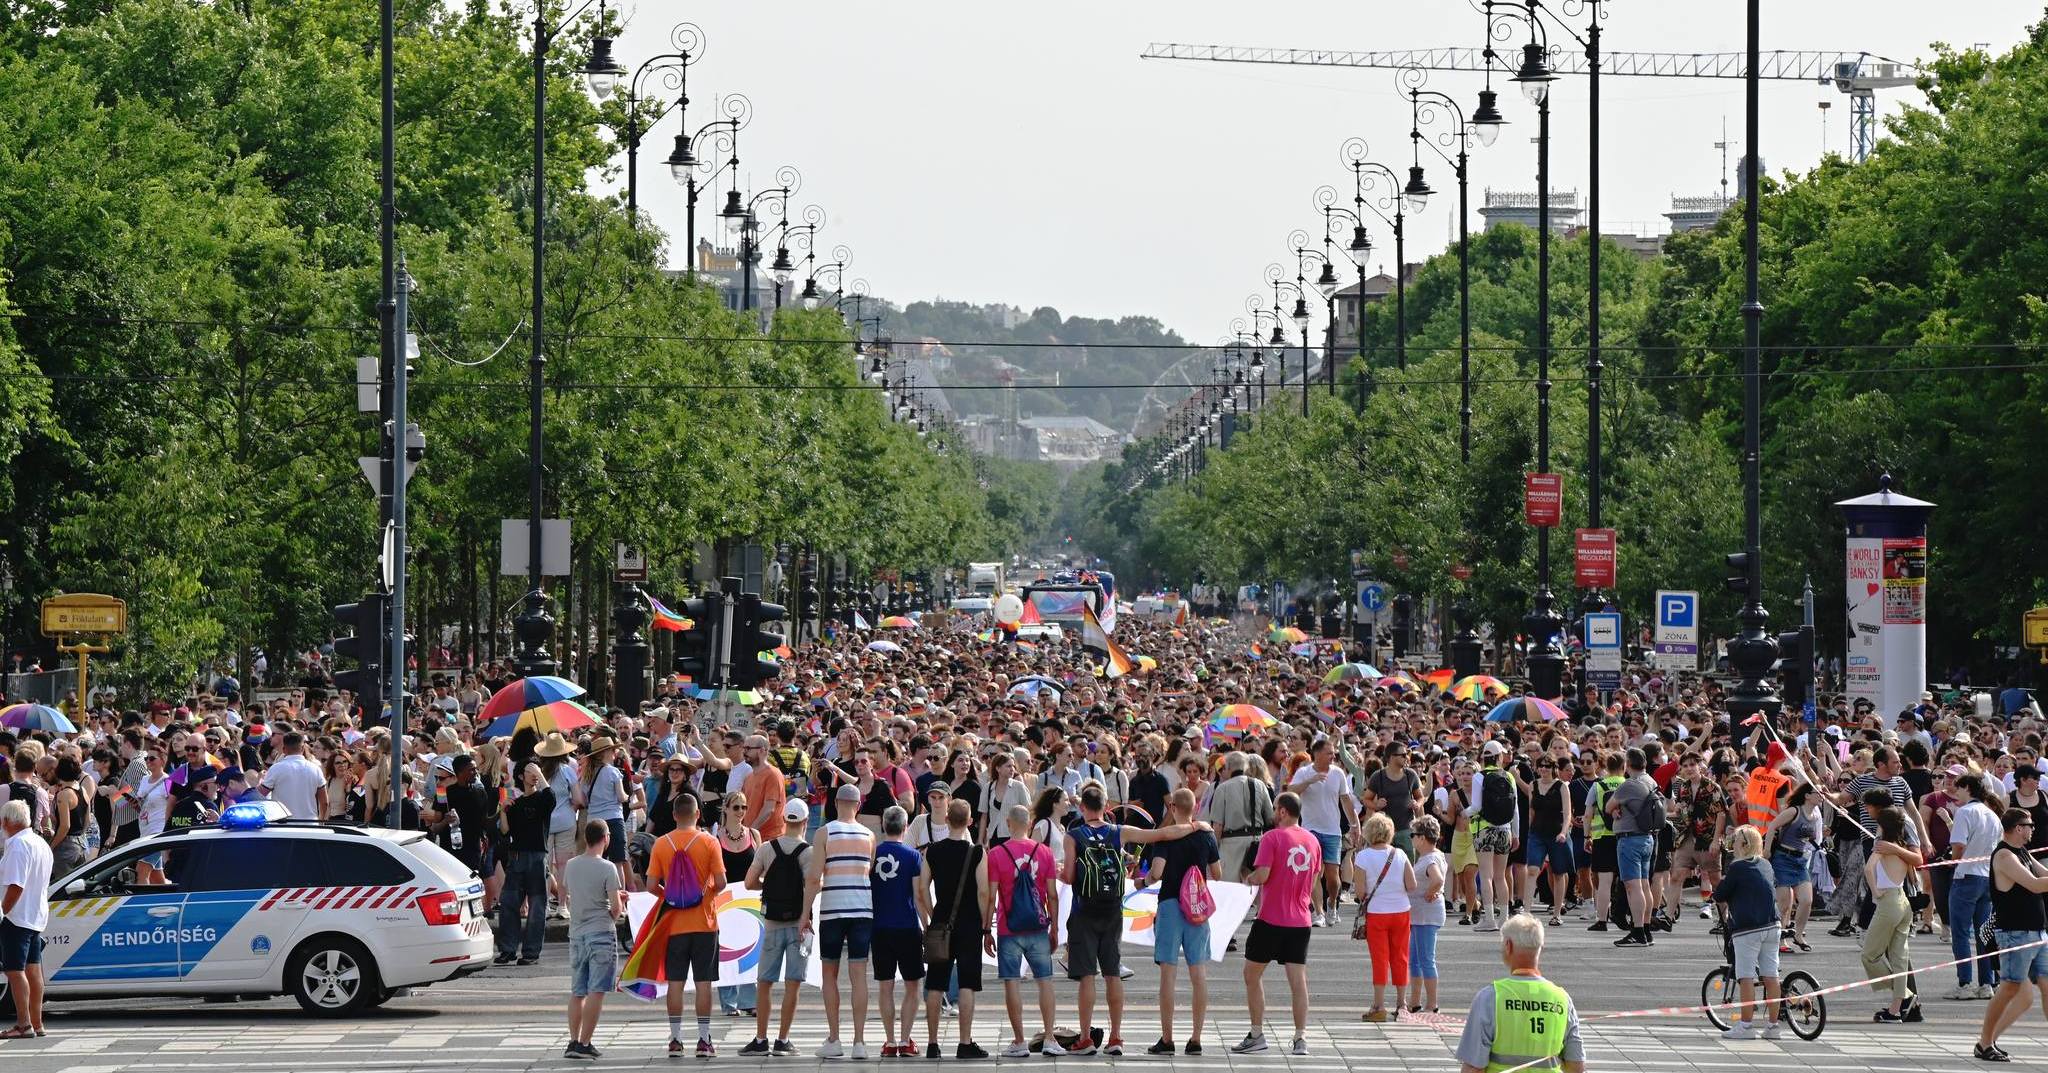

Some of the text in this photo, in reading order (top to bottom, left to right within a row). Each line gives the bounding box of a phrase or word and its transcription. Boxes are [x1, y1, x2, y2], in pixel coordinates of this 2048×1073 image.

[1853, 548, 1880, 561] WORLD
[1850, 567, 1879, 579] BANKSY
[1667, 600, 1687, 622] P
[52, 925, 216, 947] 112 RENDŐRSÉG
[1530, 1017, 1544, 1034] 15
